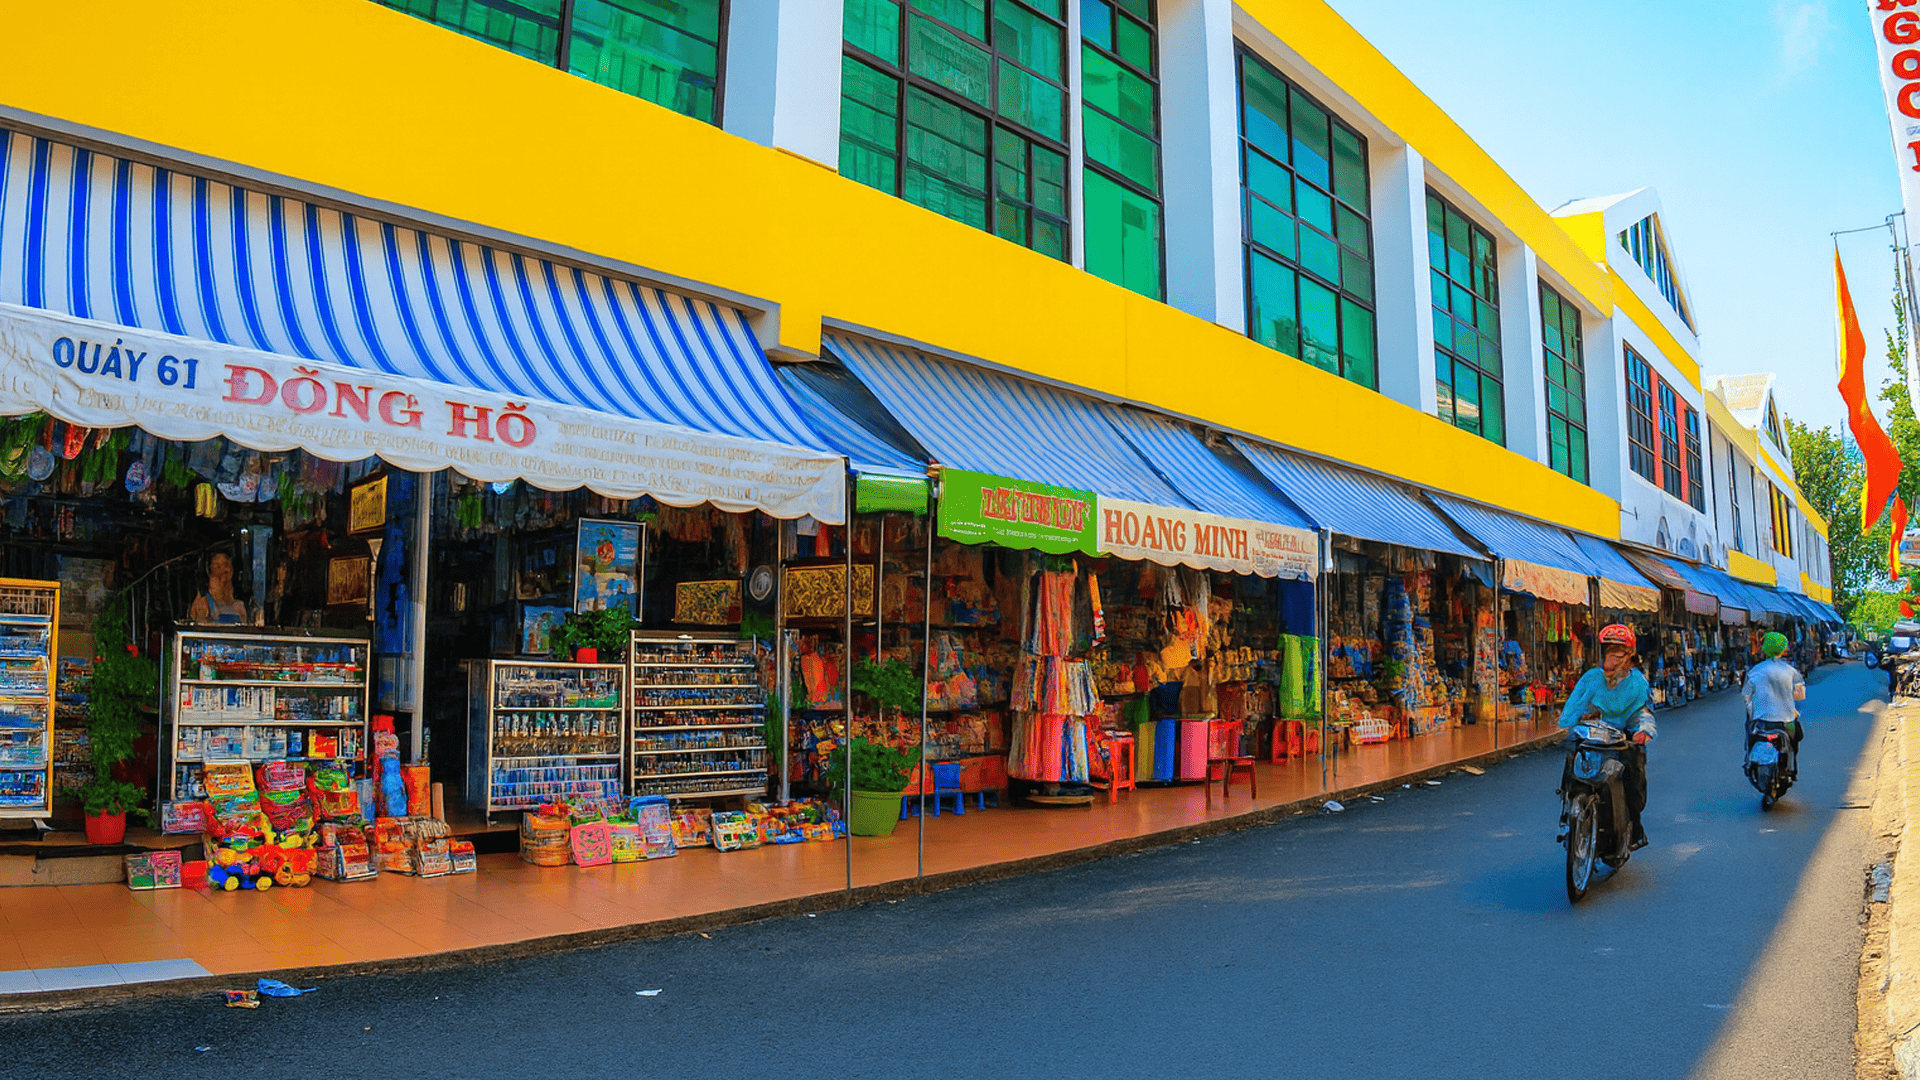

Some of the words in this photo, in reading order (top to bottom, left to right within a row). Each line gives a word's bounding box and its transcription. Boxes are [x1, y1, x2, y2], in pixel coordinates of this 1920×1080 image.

[157, 354, 199, 389] 61
[1103, 508, 1187, 552] HOANG
[1193, 522, 1250, 560] MINH
